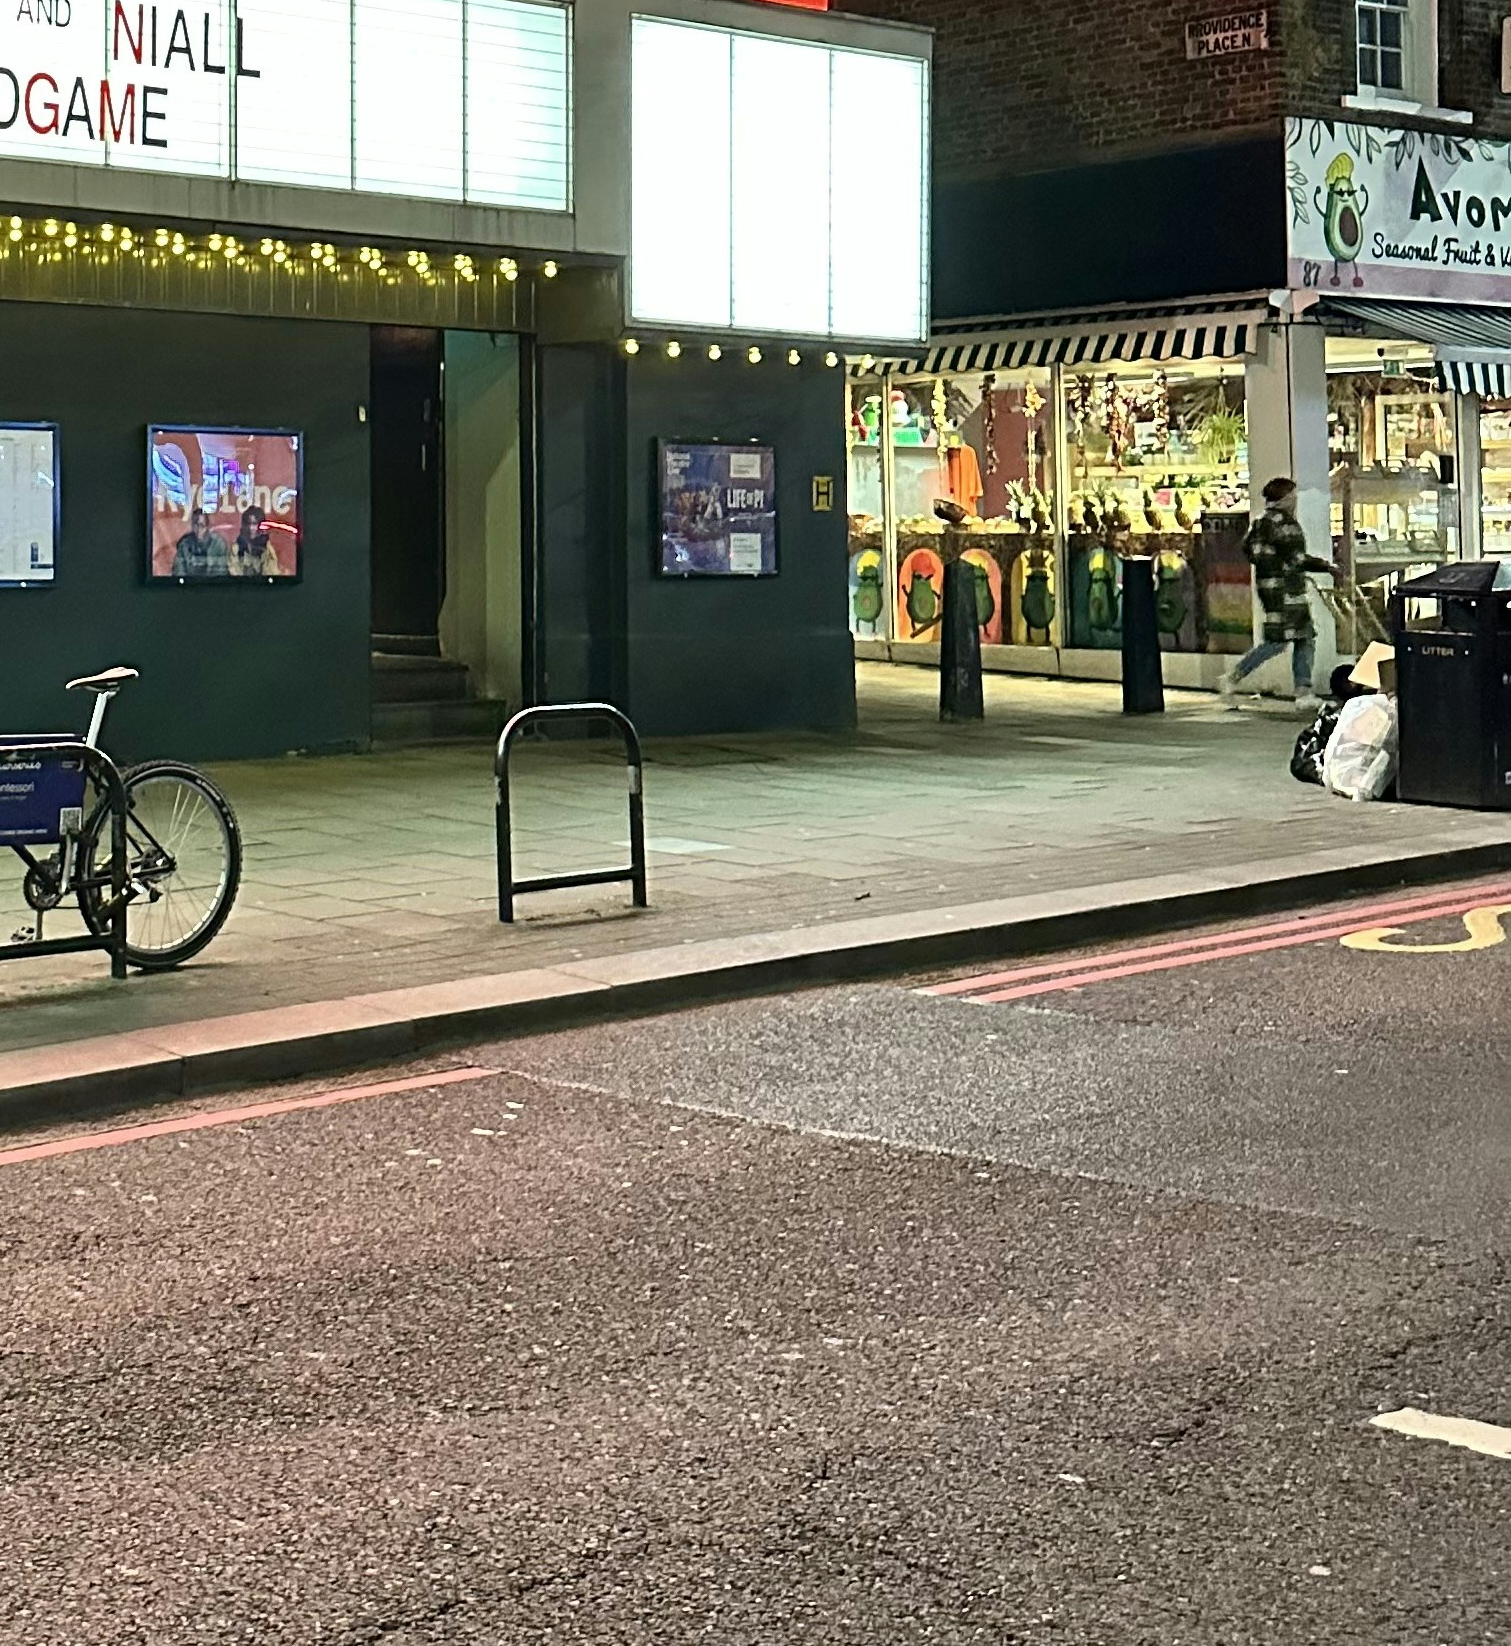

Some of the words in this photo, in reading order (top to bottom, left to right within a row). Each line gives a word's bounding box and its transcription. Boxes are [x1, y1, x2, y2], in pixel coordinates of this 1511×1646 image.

[1188, 12, 1264, 38] PROVIDENCE
[114, 0, 261, 78] NIALL
[1372, 232, 1438, 262] Seasonal
[1442, 237, 1481, 265] Fruit
[1484, 243, 1495, 267] &
[1303, 261, 1321, 287] 87
[727, 488, 746, 509] LIFE
[754, 489, 764, 509] PI
[1421, 646, 1455, 657] LITTER
